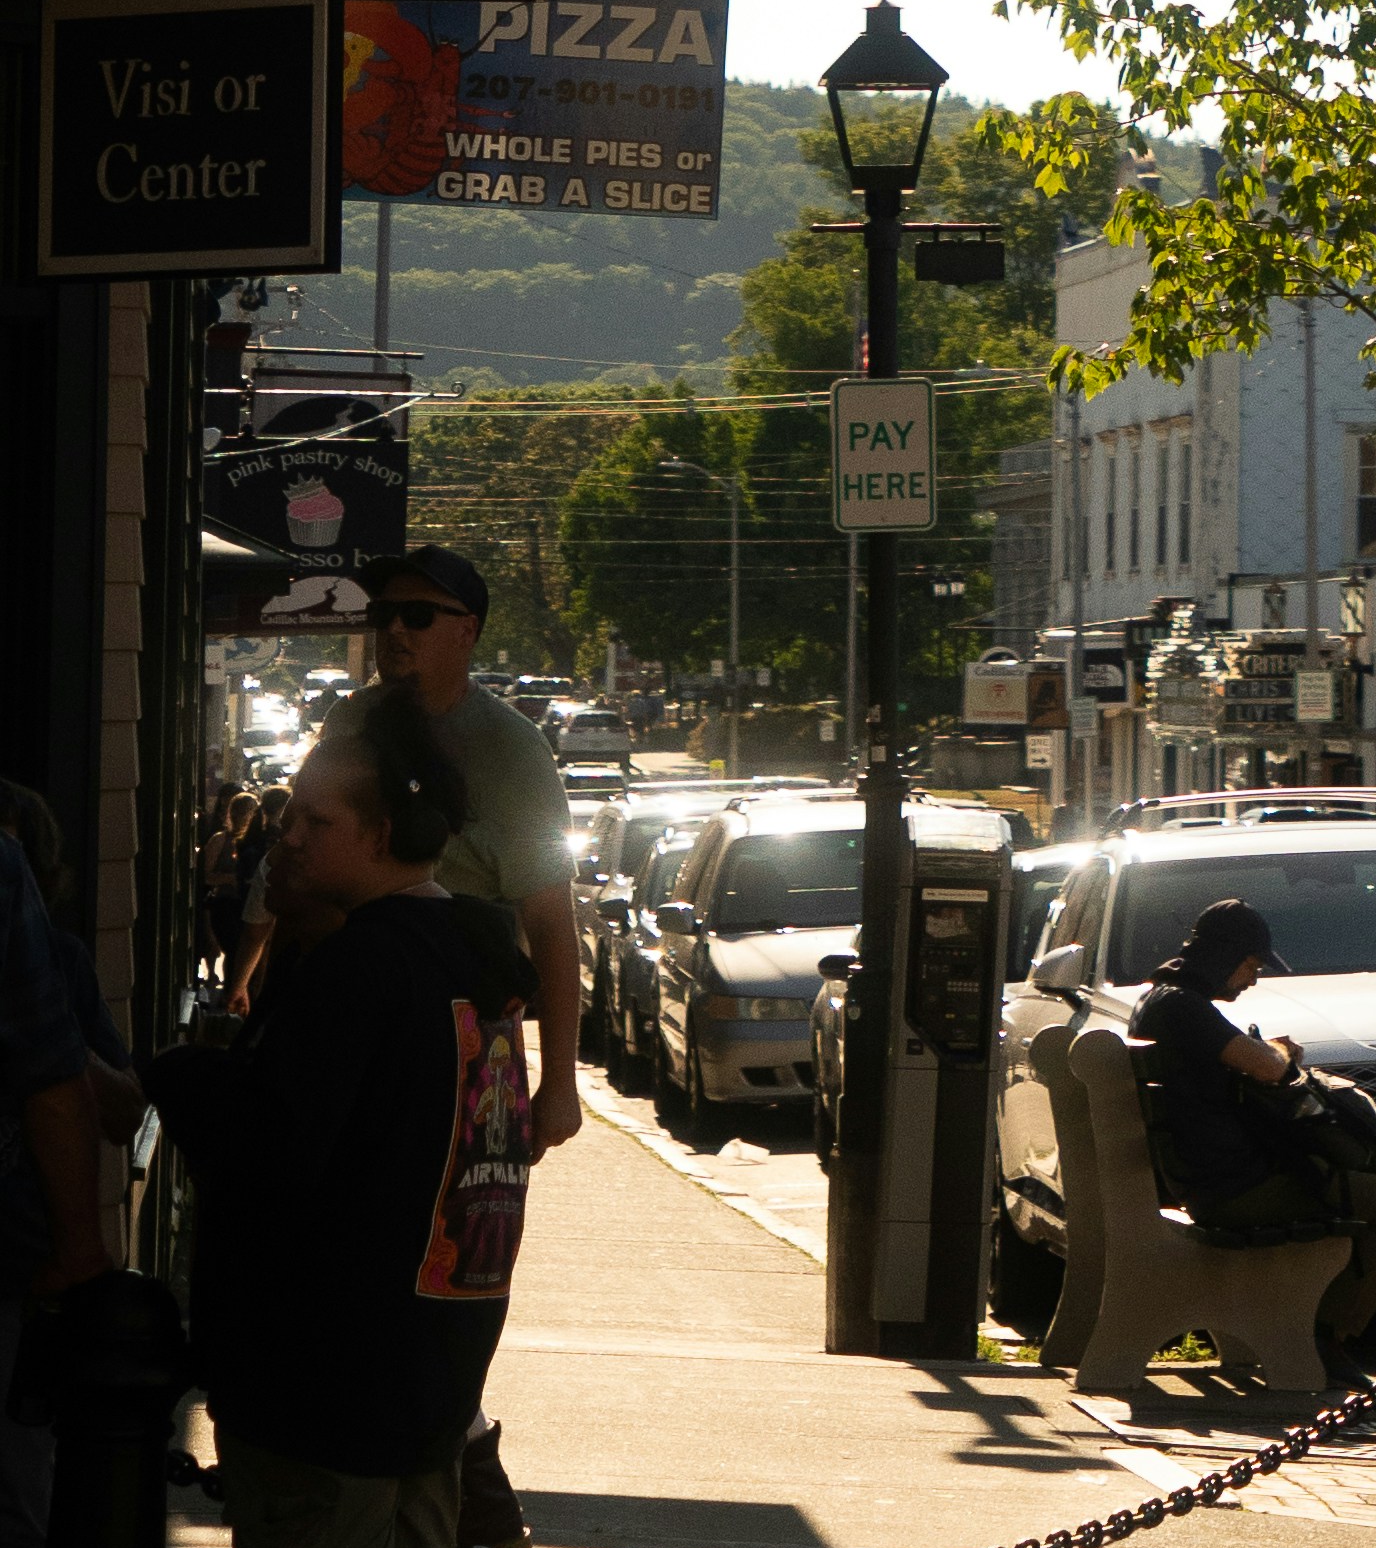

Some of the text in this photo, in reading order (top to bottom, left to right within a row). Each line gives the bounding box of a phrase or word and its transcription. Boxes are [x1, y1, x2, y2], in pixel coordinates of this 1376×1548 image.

[478, 0, 714, 65] PIZZA
[444, 131, 712, 170] WHOLE PIES or
[96, 142, 267, 204] Center
[436, 170, 712, 213] GRAB A SLICE
[847, 421, 914, 454] PAY
[226, 449, 405, 488] pink pastry shop
[842, 470, 928, 503] HERE
